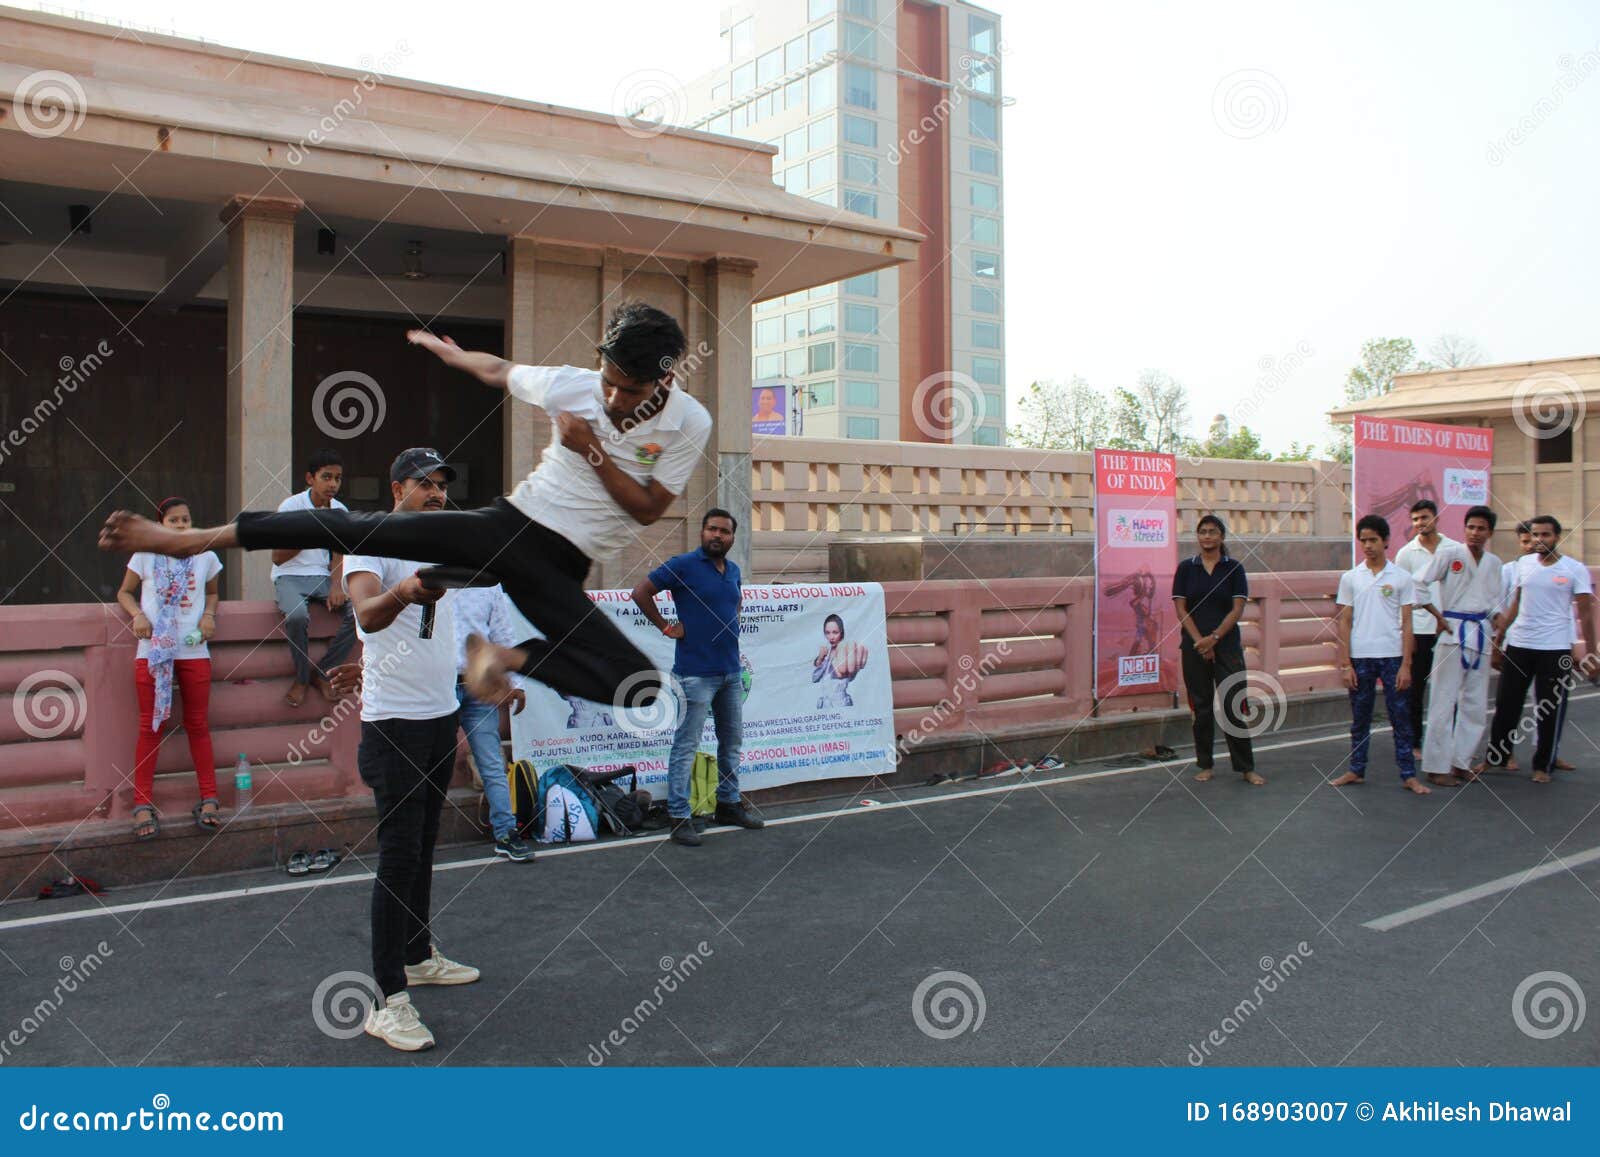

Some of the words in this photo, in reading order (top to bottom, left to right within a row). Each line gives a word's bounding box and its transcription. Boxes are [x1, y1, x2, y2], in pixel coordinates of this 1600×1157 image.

[1360, 420, 1389, 442] THE
[1392, 424, 1433, 446] TIMES
[1435, 430, 1453, 448] OF
[1456, 432, 1489, 451] INDIA
[1101, 454, 1128, 470] THE
[1132, 456, 1172, 473] TIMES
[1107, 473, 1126, 489] OF
[1129, 475, 1166, 490] INDIA
[1132, 519, 1164, 530] HAPPY
[771, 586, 829, 599] SCHOOL
[831, 585, 866, 597] INDIA
[747, 615, 785, 623] INSTITUTE
[1123, 657, 1156, 674] NBT
[617, 740, 640, 750] MIXED
[642, 738, 674, 748] MARTIAL
[804, 723, 821, 733] SELF
[747, 748, 788, 761] SCHOOL
[790, 744, 817, 757] INDIA
